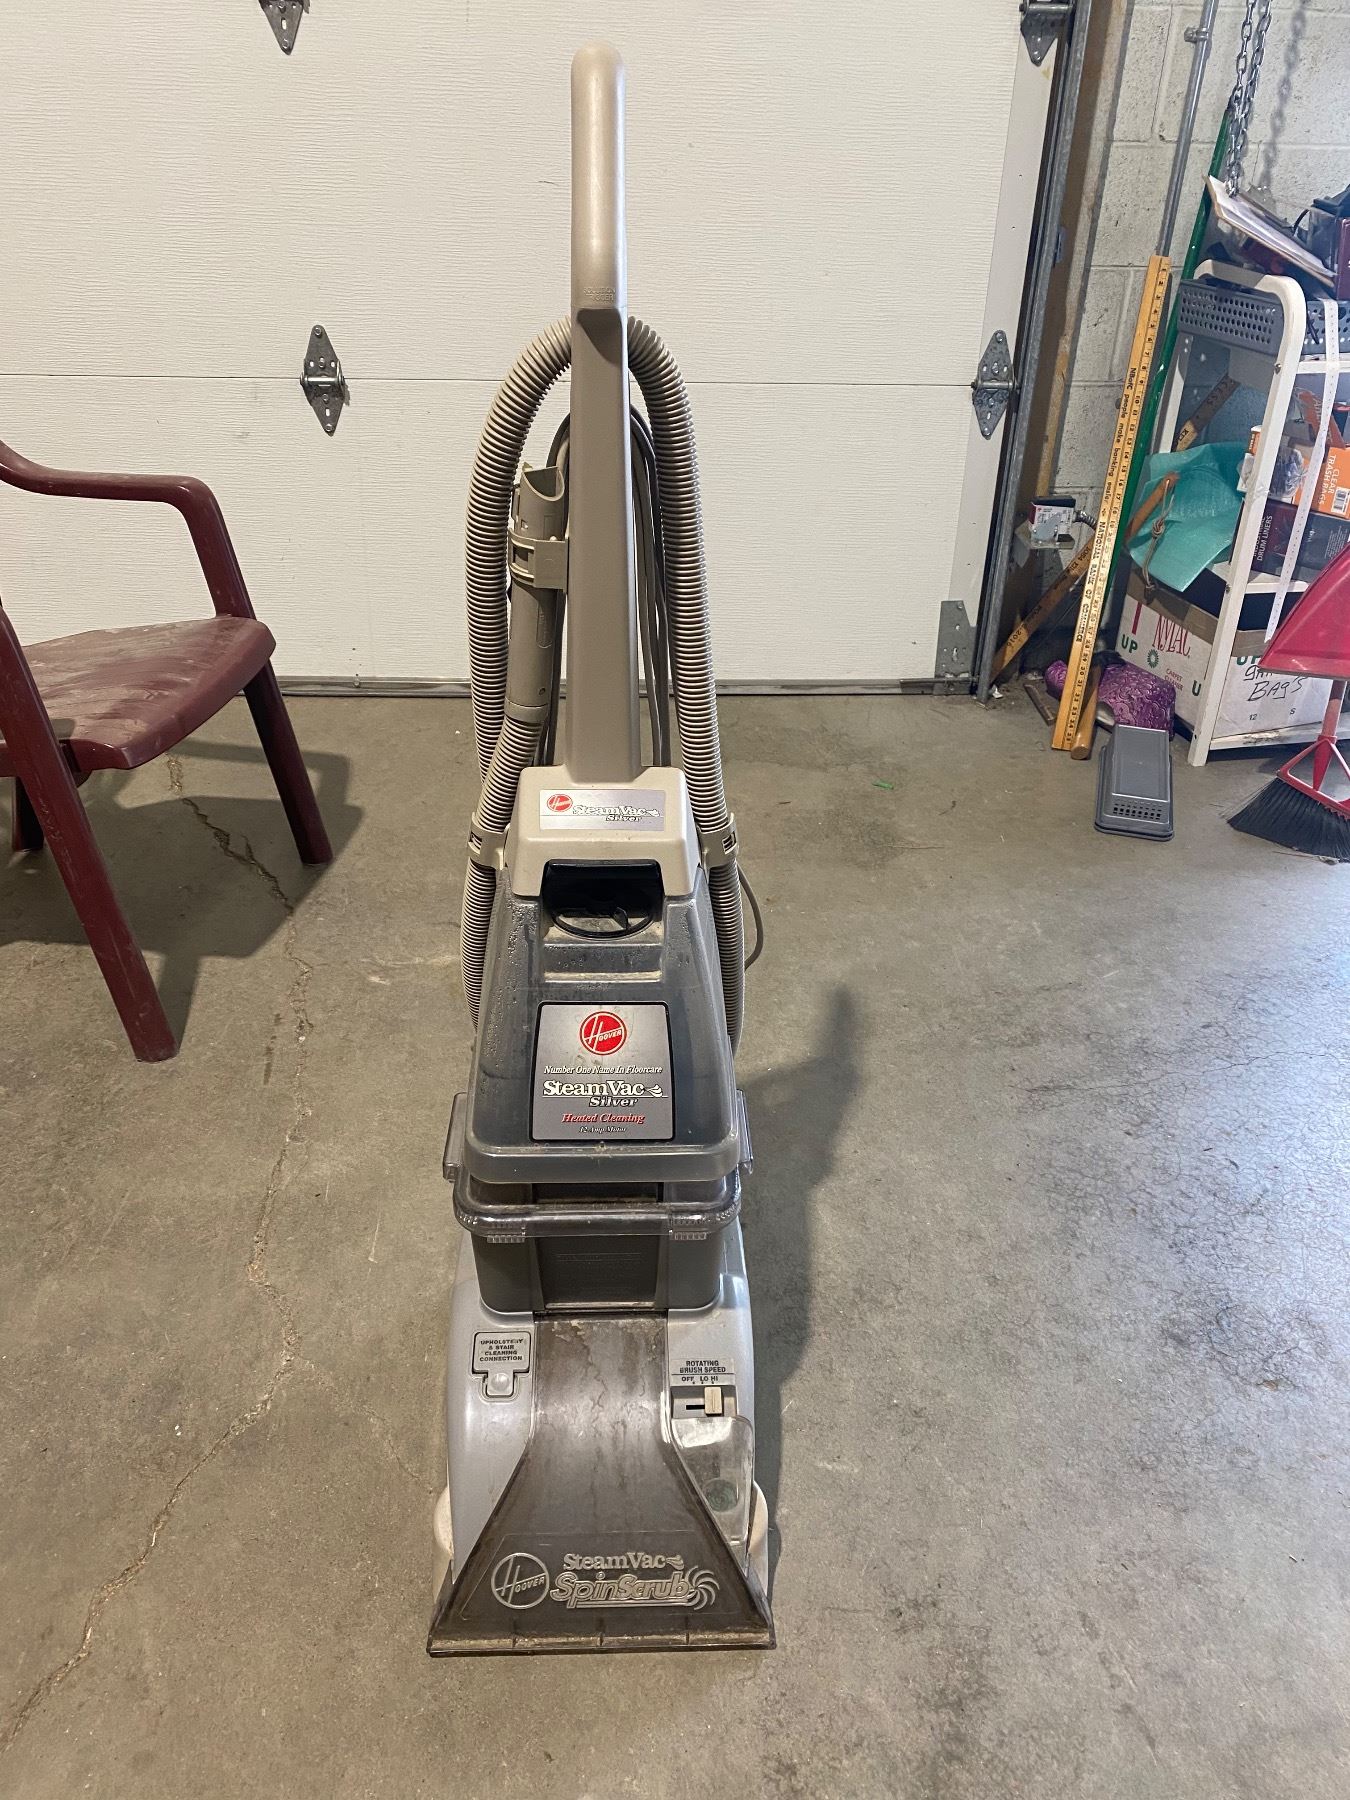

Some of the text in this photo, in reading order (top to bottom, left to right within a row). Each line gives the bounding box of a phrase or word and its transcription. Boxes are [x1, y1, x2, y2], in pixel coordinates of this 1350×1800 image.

[1120, 394, 1130, 419] people
[1134, 395, 1140, 404] 10
[1116, 423, 1124, 443] make
[1129, 424, 1135, 432] 12
[1124, 451, 1129, 459] 14
[1108, 448, 1120, 477] banking
[1323, 454, 1337, 483] TRASH
[1118, 479, 1124, 487] 16
[1327, 468, 1340, 494] CLEAR
[1116, 493, 1121, 501] 17
[1093, 521, 1106, 559] NATIONAL
[1256, 515, 1273, 561] DRUM LINERS
[1087, 564, 1097, 585] BANK
[1085, 590, 1092, 599] OF
[1076, 604, 1089, 642] COMMERCE
[1121, 634, 1138, 654] UP
[1080, 666, 1085, 675] 30
[1165, 668, 1183, 681] CARPET
[1164, 675, 1184, 691] CLEANER
[1192, 680, 1202, 696] U
[1249, 713, 1258, 721] 12
[573, 805, 646, 816] SteamVac
[606, 814, 642, 822] Silver
[543, 1065, 663, 1075] Number One Name In Floorcare
[543, 1080, 646, 1096] SteamVac
[588, 1096, 638, 1108] Silver
[561, 1113, 646, 1125] Heated Cleaning
[589, 1126, 605, 1135] Amp
[563, 1552, 666, 1570] SteamVac
[550, 1571, 692, 1609] SpinScrub
